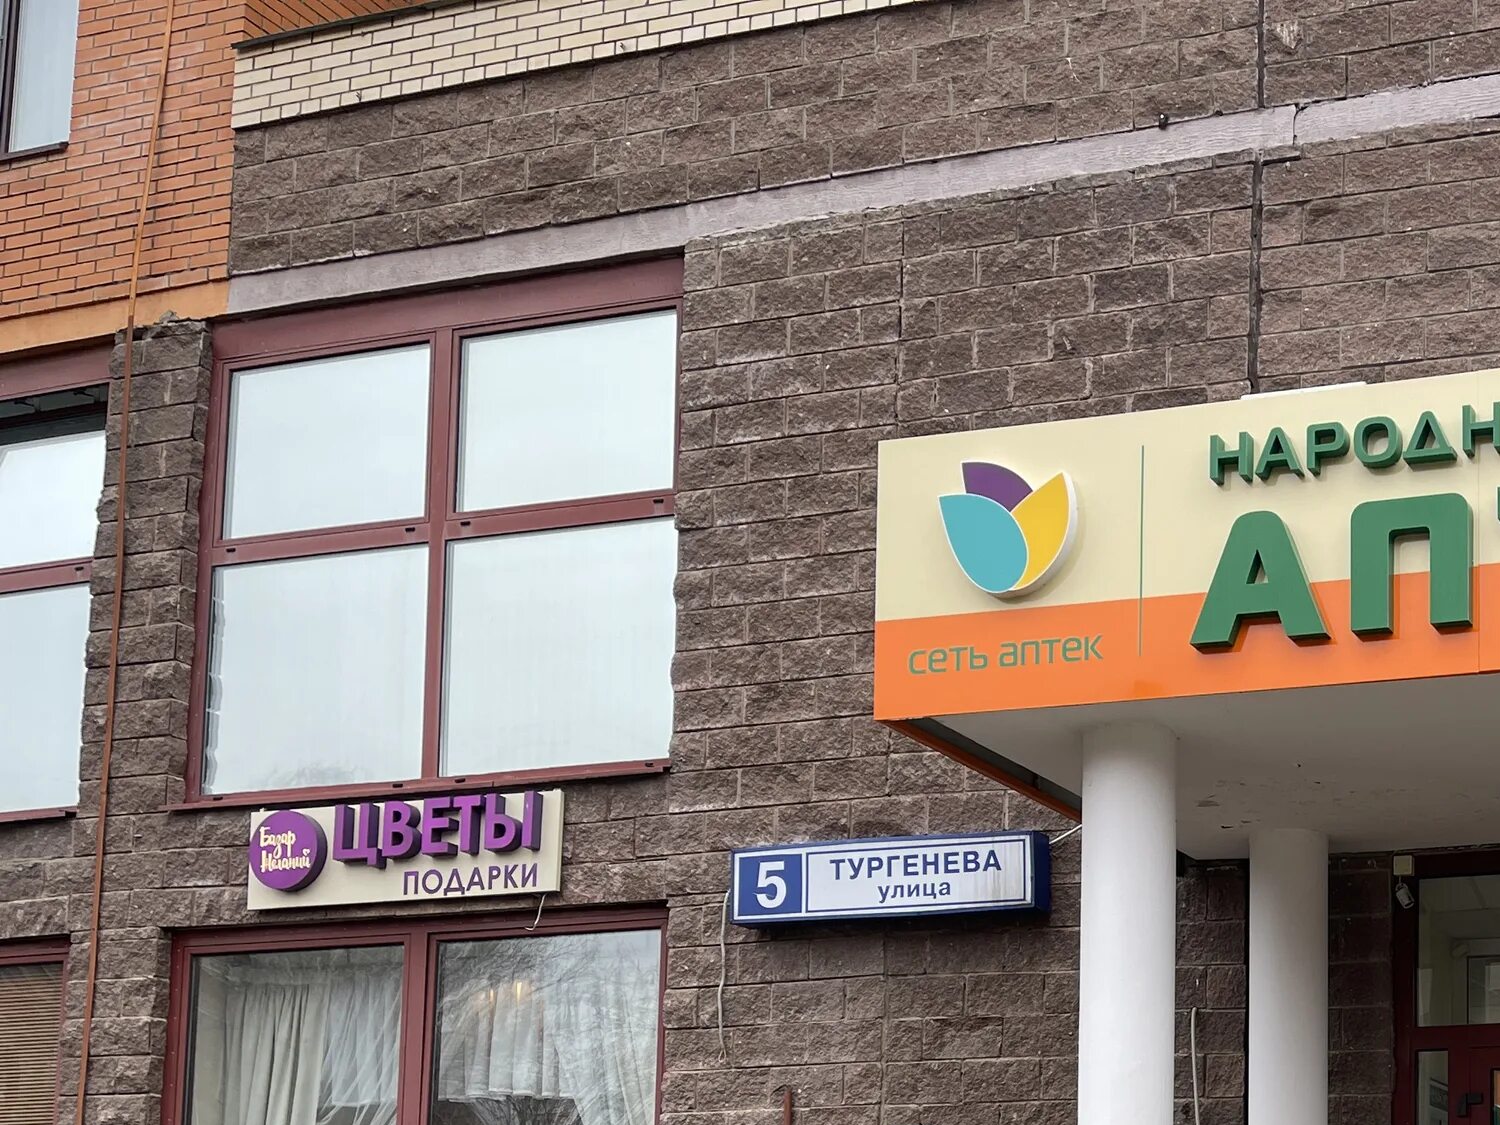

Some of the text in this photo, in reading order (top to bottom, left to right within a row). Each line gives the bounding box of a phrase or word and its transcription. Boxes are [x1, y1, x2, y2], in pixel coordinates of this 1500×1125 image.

[907, 631, 1104, 676] сеть аптек
[332, 790, 543, 869] ЦВЕТЫ
[403, 863, 538, 896] ПОДАРКИ
[752, 860, 787, 909] 5
[830, 850, 1001, 880] ТУРГЕНЕВА
[878, 881, 951, 903] улица
